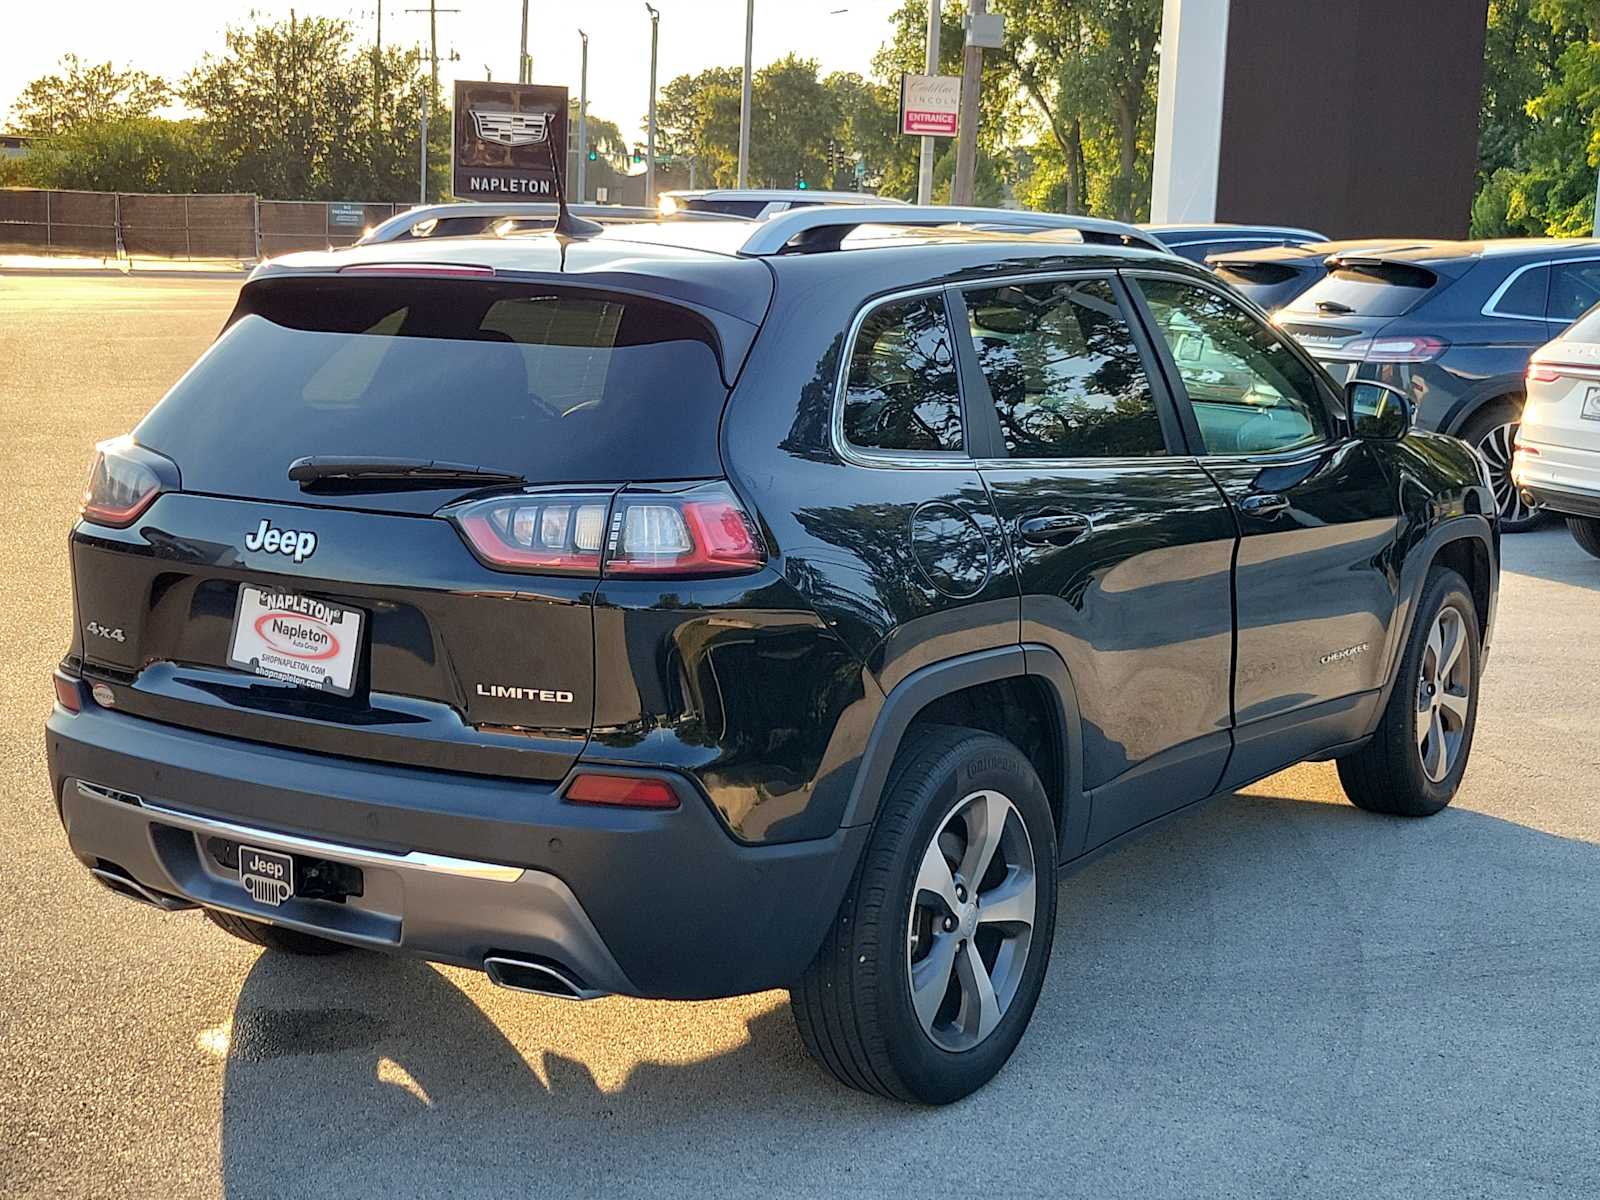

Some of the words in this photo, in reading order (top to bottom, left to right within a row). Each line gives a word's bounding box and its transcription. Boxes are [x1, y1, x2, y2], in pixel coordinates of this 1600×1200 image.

[908, 112, 954, 123] ENTRANCE
[470, 177, 550, 194] NAPLETON
[245, 519, 318, 562] Jeep
[266, 593, 335, 624] NAPLETON
[86, 621, 126, 642] 4x4
[272, 618, 328, 645] Napleton
[292, 641, 304, 649] Auto
[304, 643, 319, 653] Group
[261, 653, 326, 676] SHOPNAPLETON.COM
[255, 666, 323, 690] shopnapleton.com
[476, 683, 574, 703] LIMITED
[249, 854, 284, 879] Jeep
